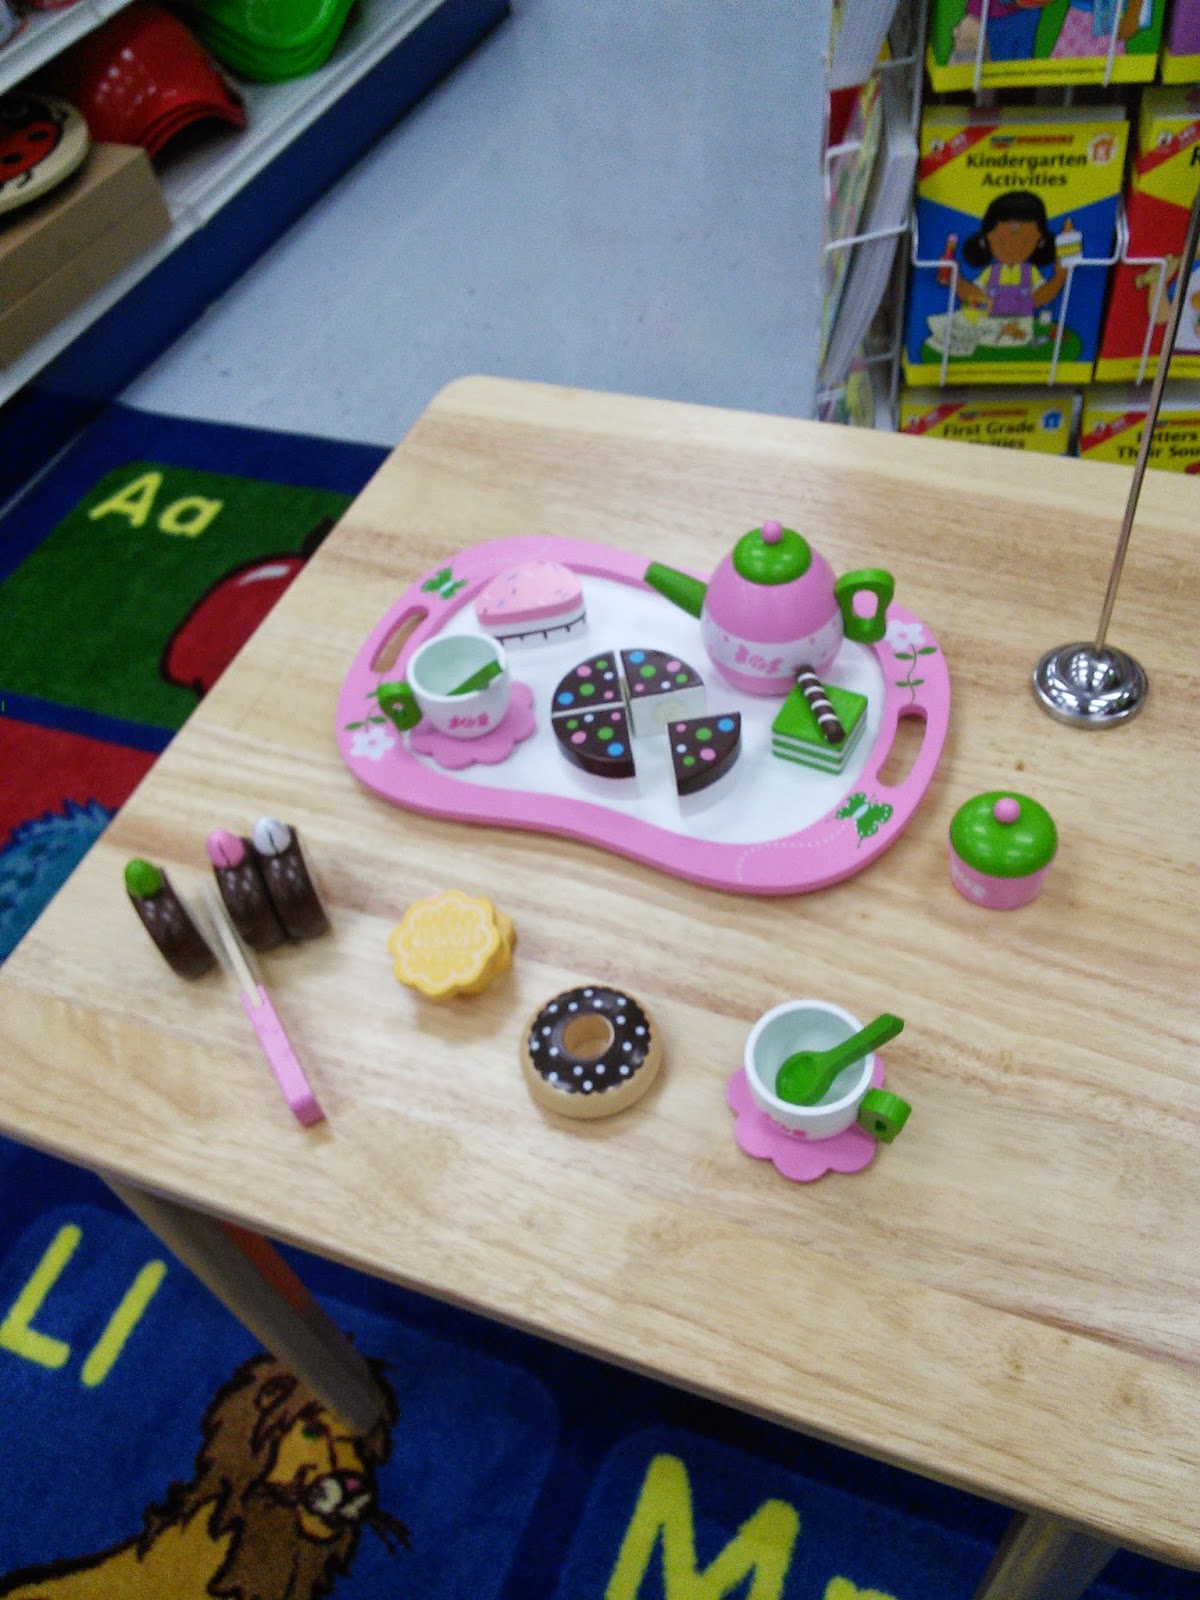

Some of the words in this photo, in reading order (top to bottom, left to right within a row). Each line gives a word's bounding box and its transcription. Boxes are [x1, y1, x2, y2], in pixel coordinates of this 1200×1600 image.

[966, 152, 1088, 171] Kindergarten
[981, 172, 1067, 187] Activities
[943, 422, 981, 437] First
[985, 419, 1035, 434] Grade
[1136, 429, 1199, 443] Ltters
[88, 470, 224, 537] Aa
